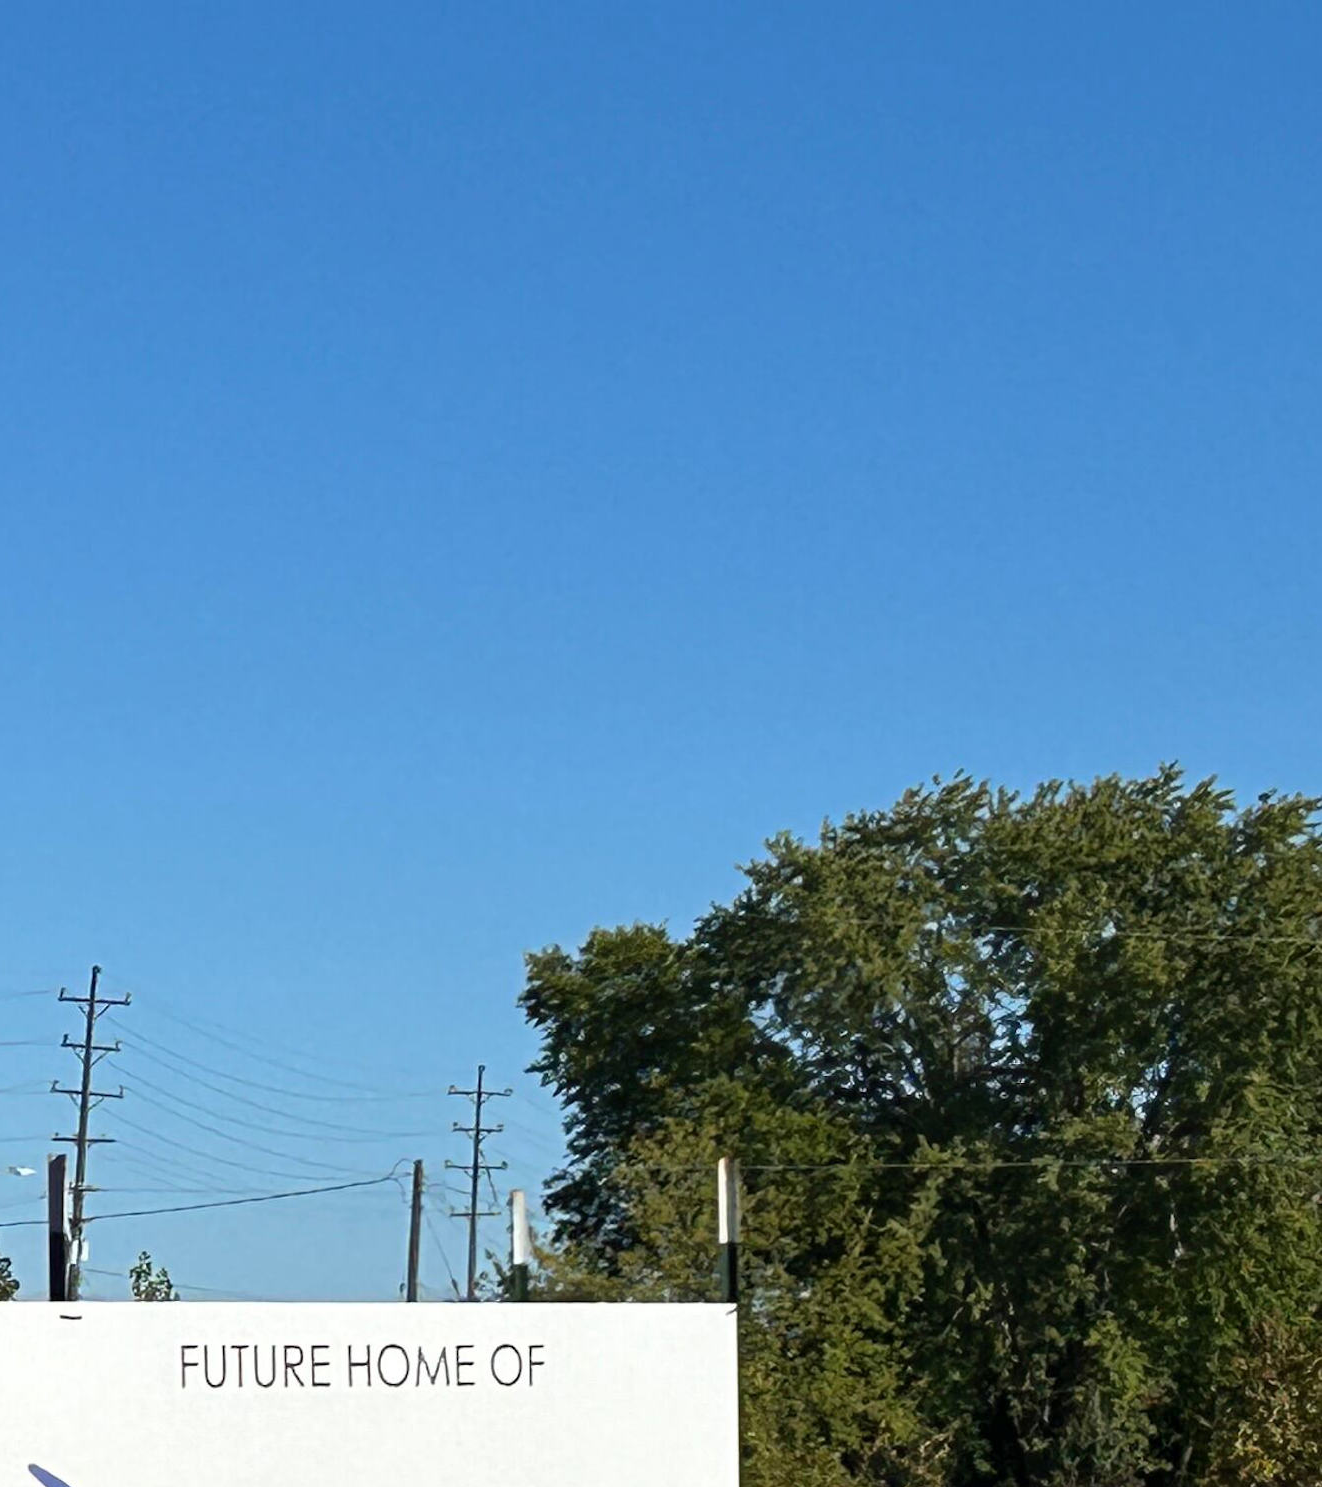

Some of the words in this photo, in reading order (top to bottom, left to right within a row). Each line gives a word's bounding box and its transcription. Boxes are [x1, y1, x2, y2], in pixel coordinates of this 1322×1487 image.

[180, 1344, 331, 1389] FUTURE
[347, 1343, 476, 1388] HOME
[490, 1343, 545, 1387] OF
